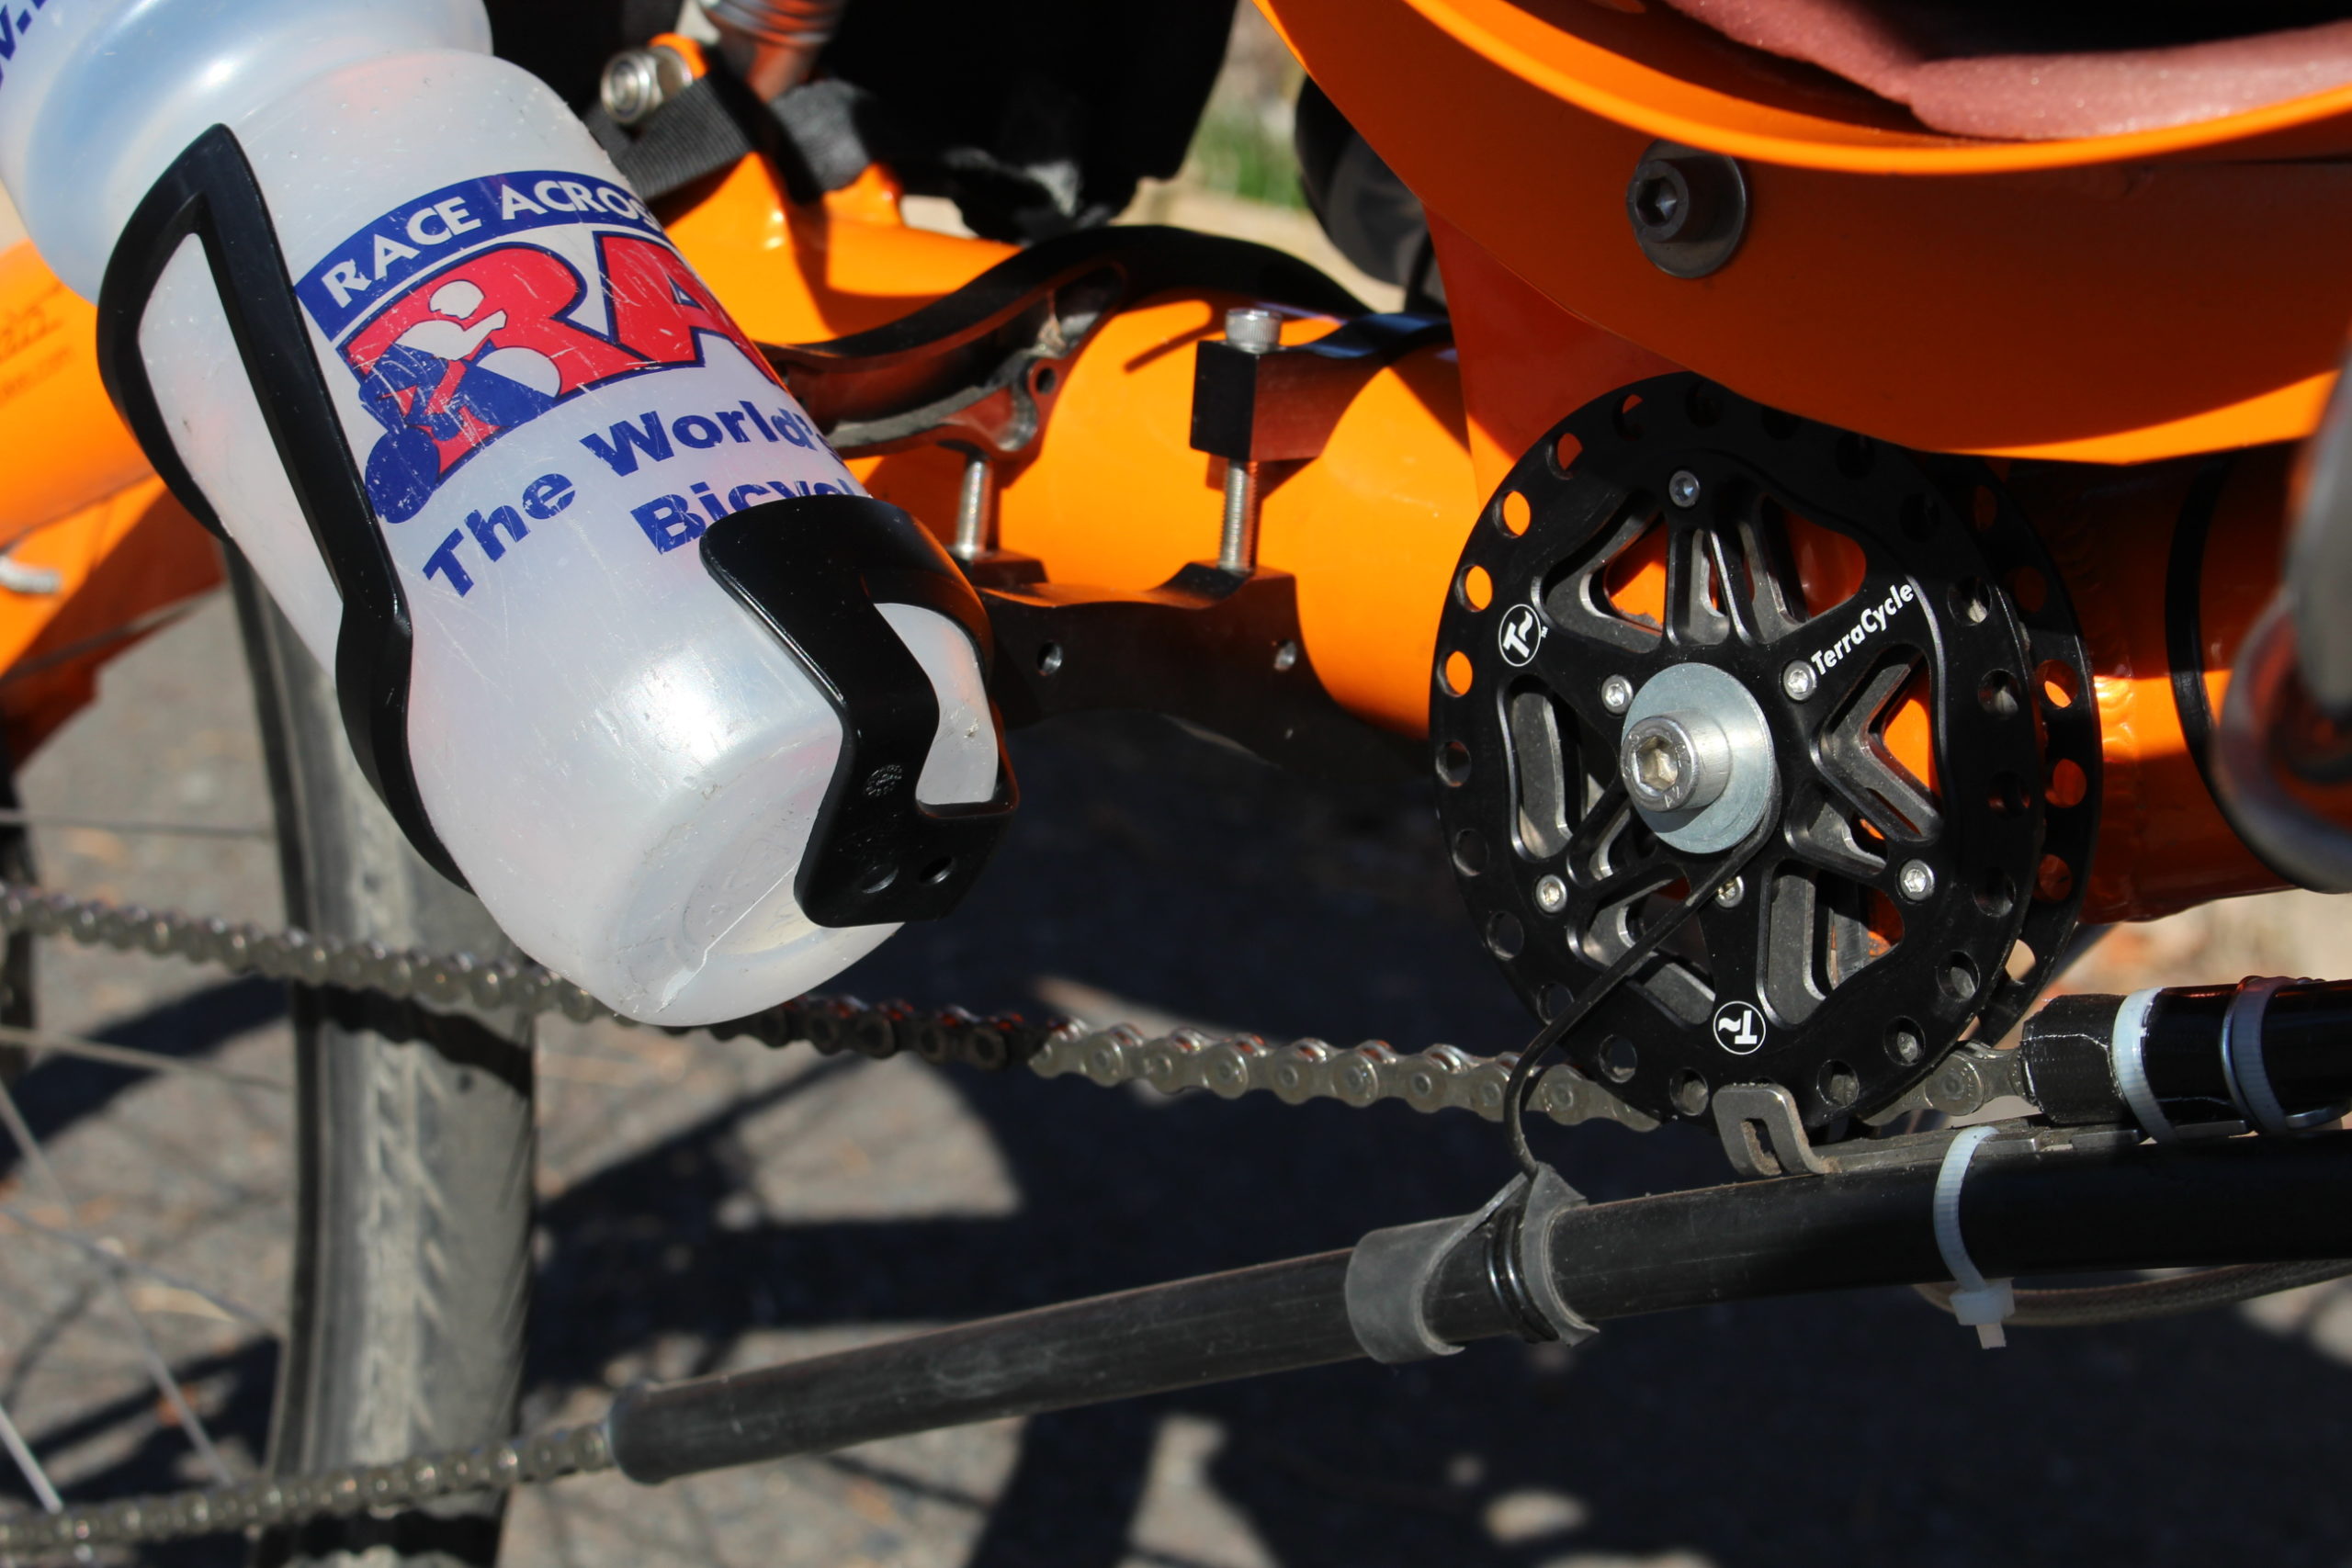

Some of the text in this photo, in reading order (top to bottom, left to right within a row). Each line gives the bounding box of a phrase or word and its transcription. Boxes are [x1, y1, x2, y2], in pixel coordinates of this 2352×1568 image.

[321, 180, 662, 309] RACE ACROS
[422, 472, 577, 599] The
[1810, 583, 1915, 676] TerraCycle
